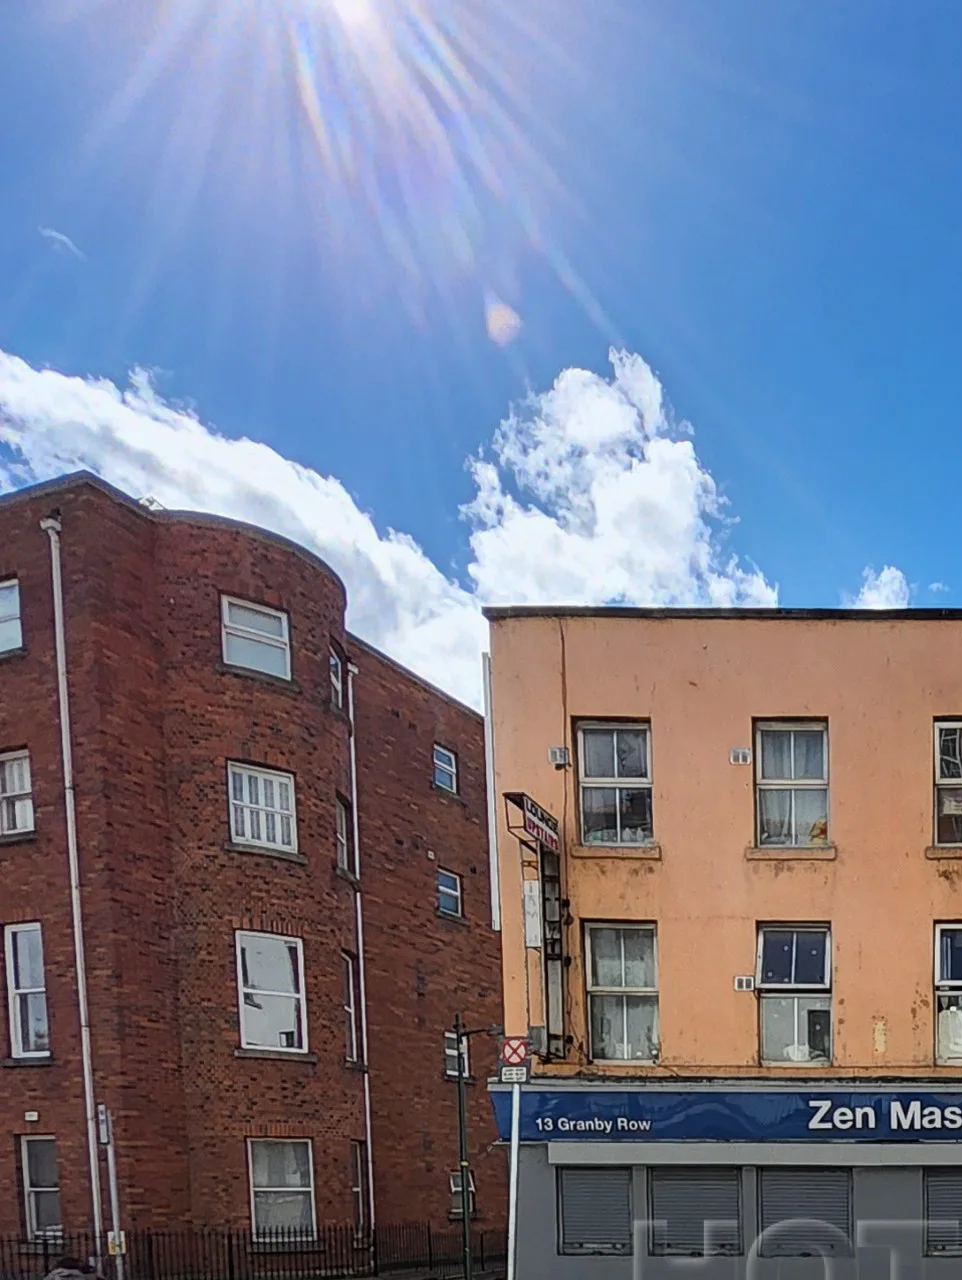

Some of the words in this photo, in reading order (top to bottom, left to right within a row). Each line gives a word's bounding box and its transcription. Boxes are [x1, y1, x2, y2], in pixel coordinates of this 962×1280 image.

[536, 1117, 553, 1131] 13
[557, 1117, 613, 1134] Granby
[617, 1117, 651, 1131] Row
[808, 1100, 876, 1130] Zen
